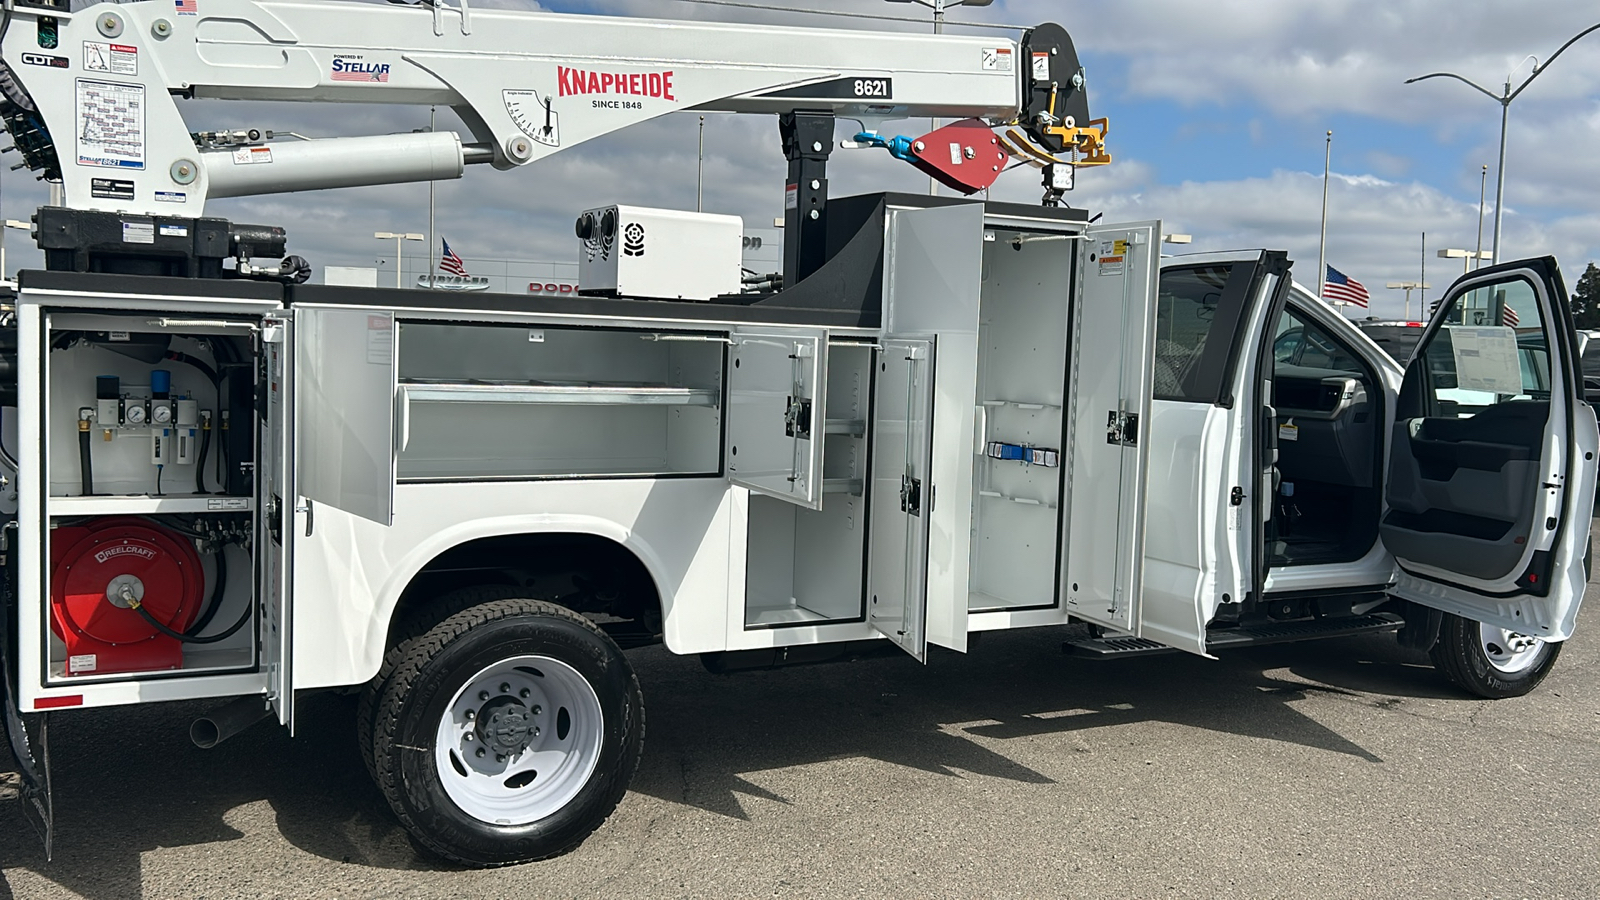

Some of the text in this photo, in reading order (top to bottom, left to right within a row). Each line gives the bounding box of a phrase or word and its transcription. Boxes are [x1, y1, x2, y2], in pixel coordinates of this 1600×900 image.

[22, 53, 54, 66] CDT
[332, 58, 390, 74] STELLAR
[557, 65, 675, 101] KNAPHEIDE
[854, 79, 887, 96] 8621
[592, 100, 642, 110] SINCE 1848
[104, 546, 154, 558] REELCRAFT
